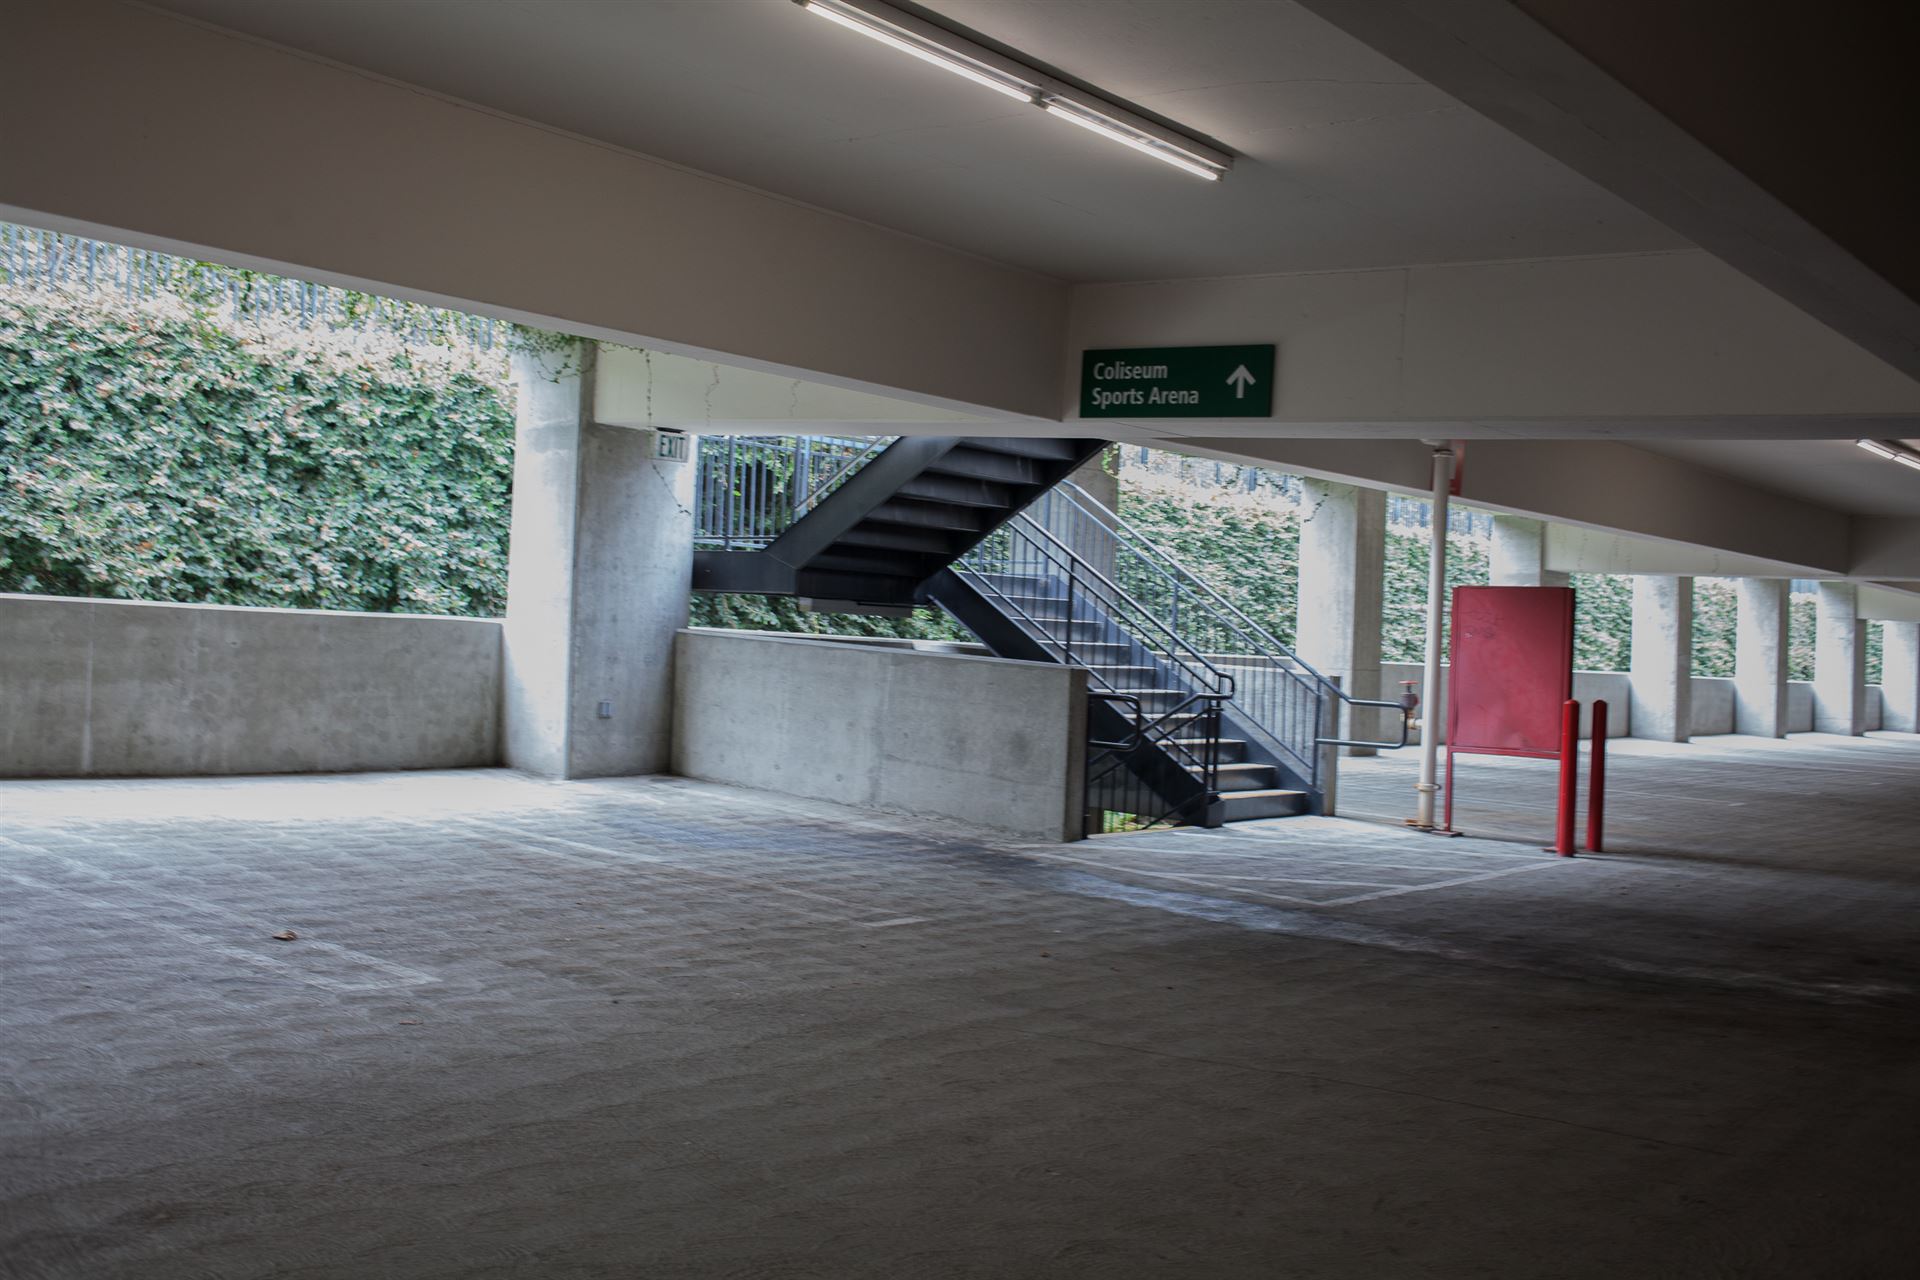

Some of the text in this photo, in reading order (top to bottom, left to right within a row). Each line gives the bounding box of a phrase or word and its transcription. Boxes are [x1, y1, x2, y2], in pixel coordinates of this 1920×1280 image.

[1093, 361, 1168, 380] Coliseum
[1092, 387, 1199, 409] Sports Arena
[660, 434, 686, 459] EXIT
